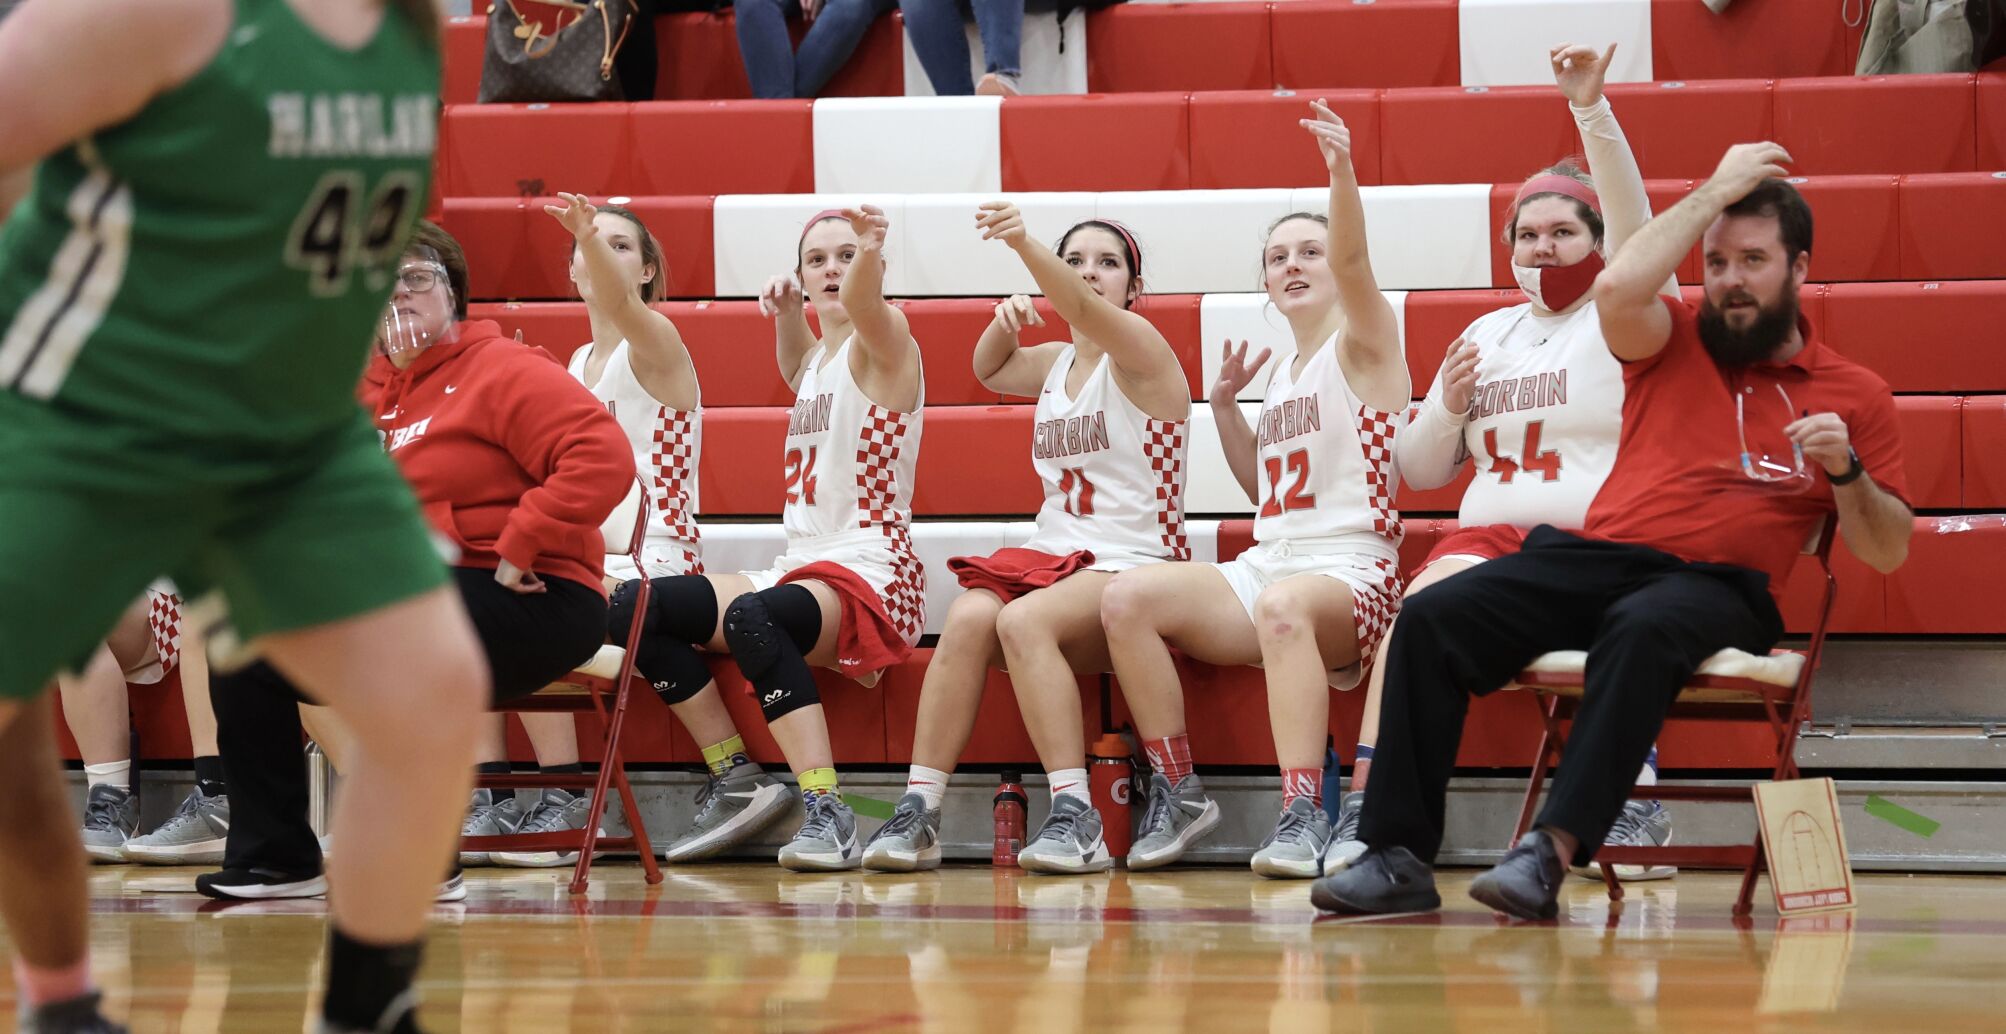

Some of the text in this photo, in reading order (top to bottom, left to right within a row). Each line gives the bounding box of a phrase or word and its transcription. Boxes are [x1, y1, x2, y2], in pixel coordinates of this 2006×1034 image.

[284, 172, 424, 297] 44
[1469, 369, 1567, 422] CORBIN
[785, 445, 818, 506] 24
[1259, 447, 1317, 520] 22
[1483, 419, 1563, 485] 44
[1110, 777, 1130, 805] G
